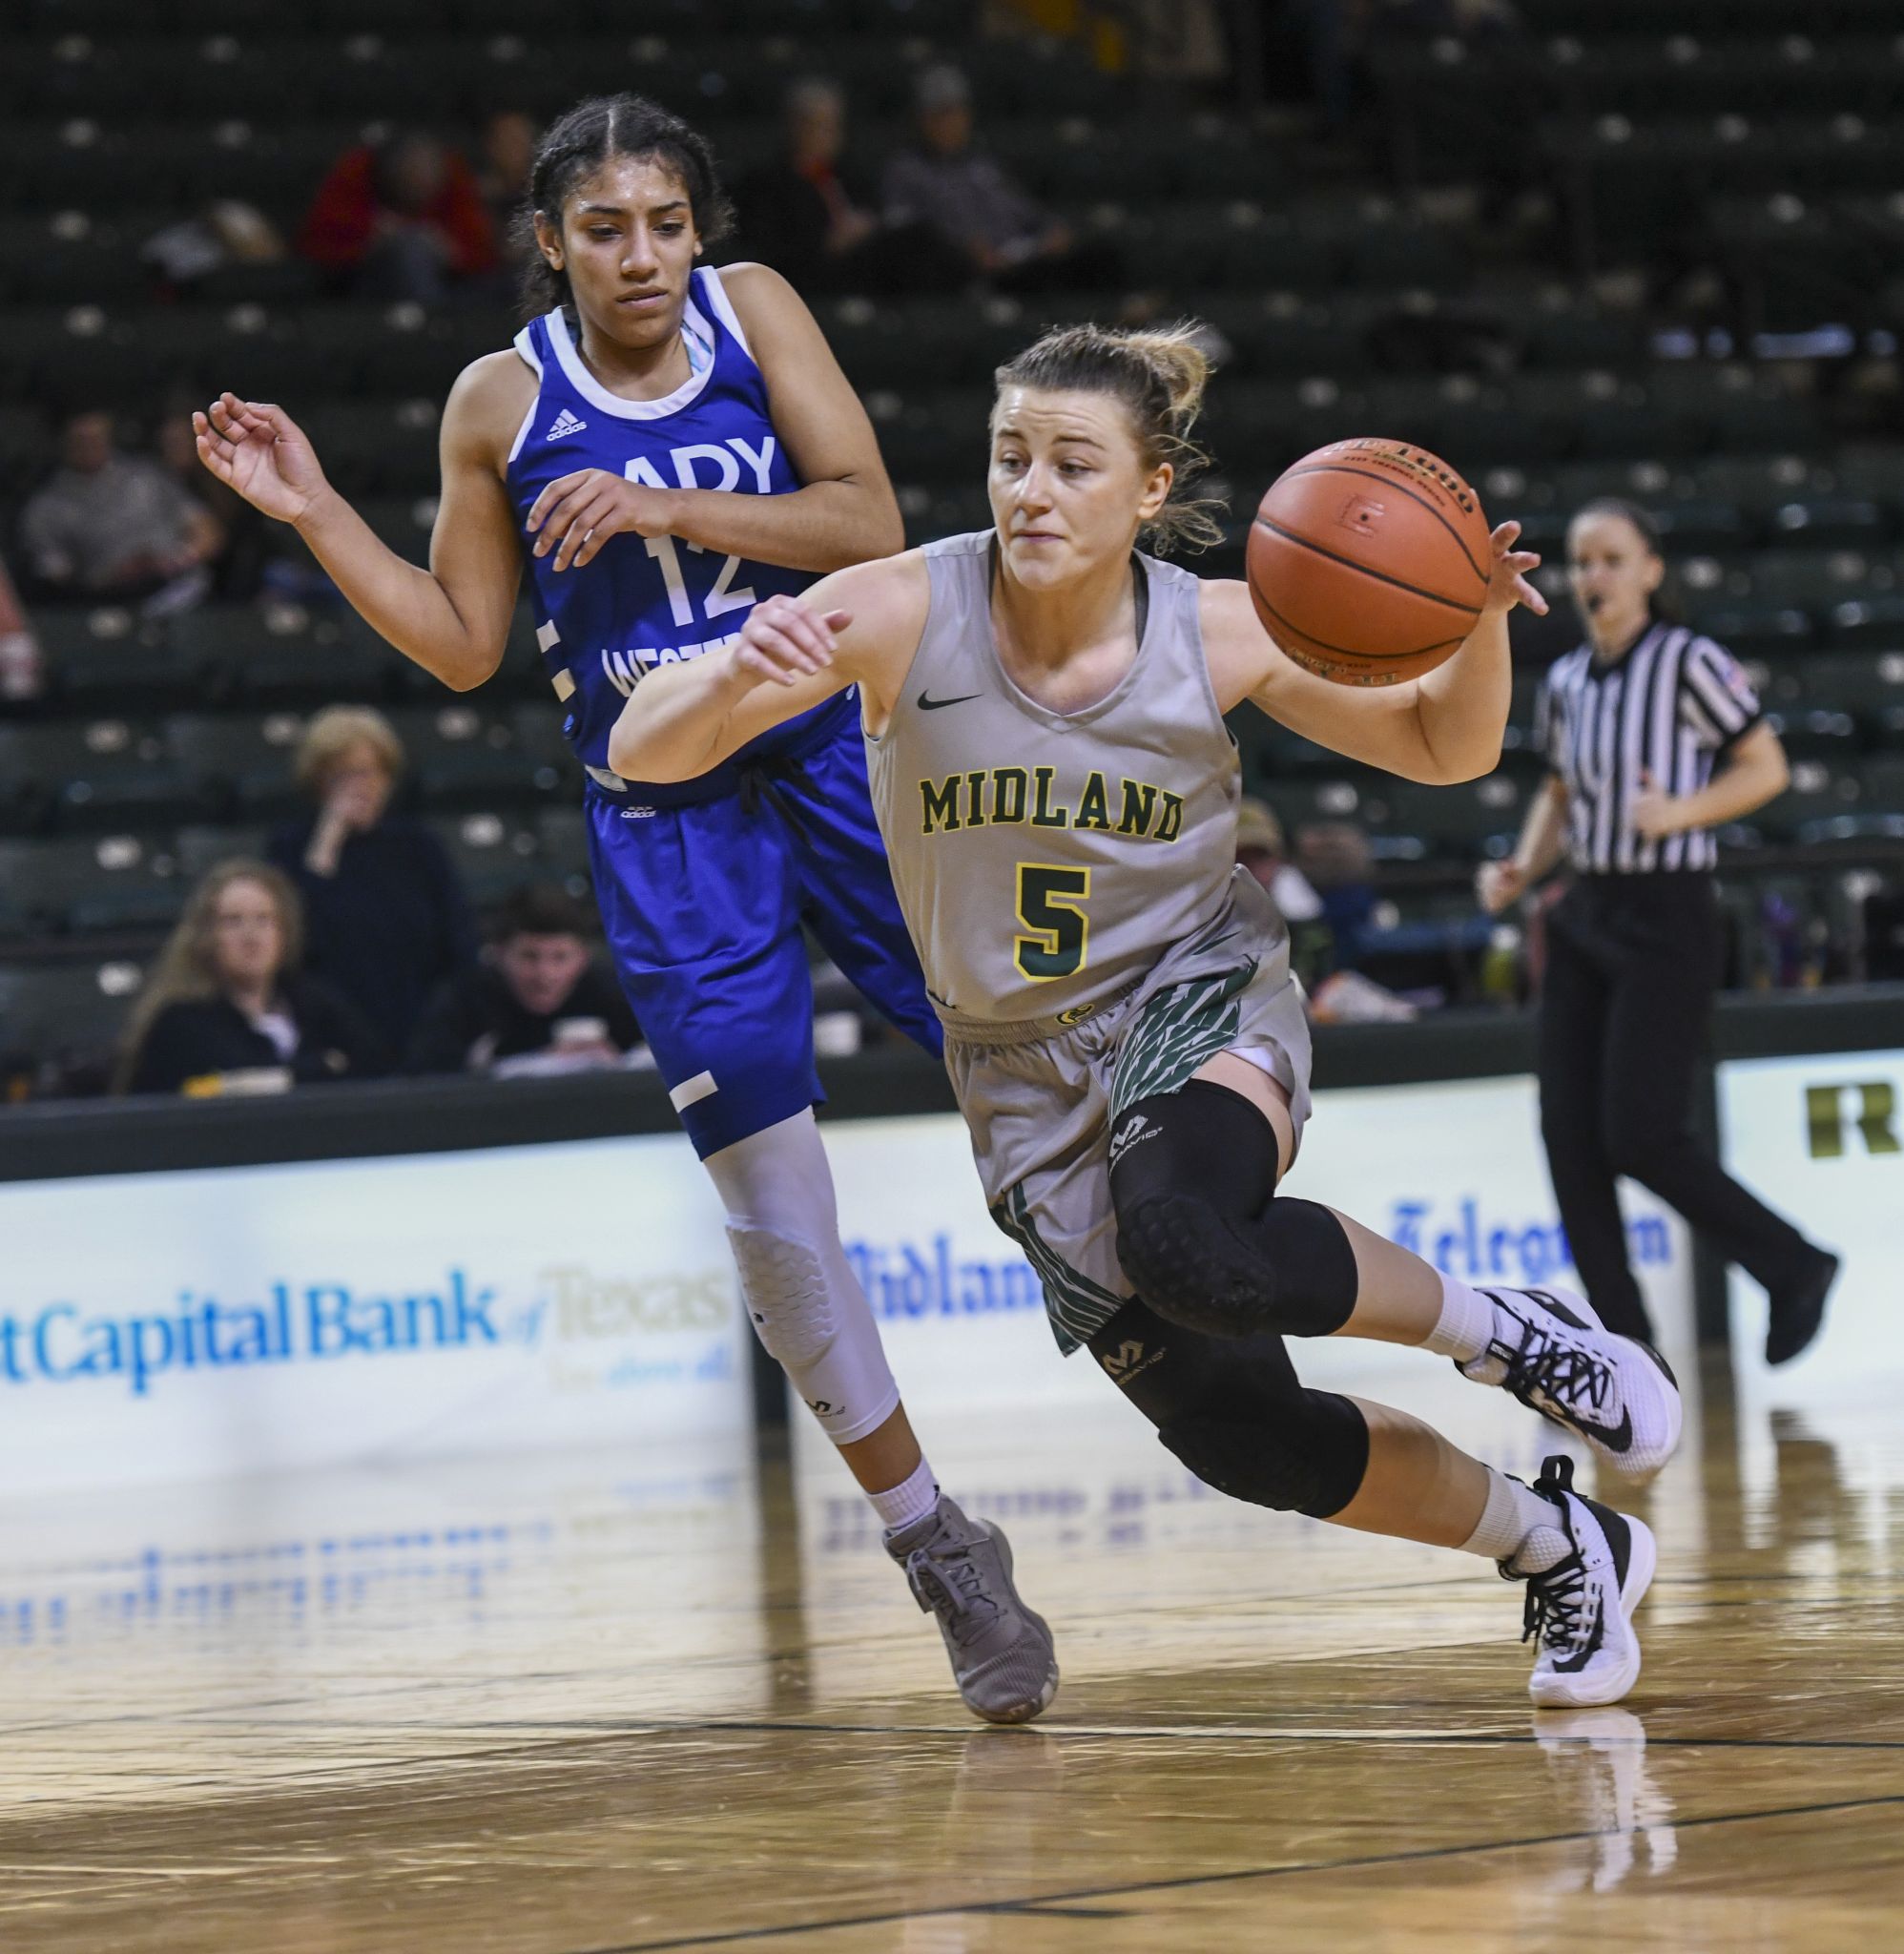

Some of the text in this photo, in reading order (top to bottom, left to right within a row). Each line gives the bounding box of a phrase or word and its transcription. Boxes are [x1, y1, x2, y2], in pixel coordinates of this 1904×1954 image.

[546, 421, 588, 442] adidas
[624, 436, 776, 494] ADY
[643, 533, 757, 628] 12
[620, 810, 657, 819] adidas
[919, 766, 1186, 843] MIDLAND
[1013, 862, 1091, 982] 5
